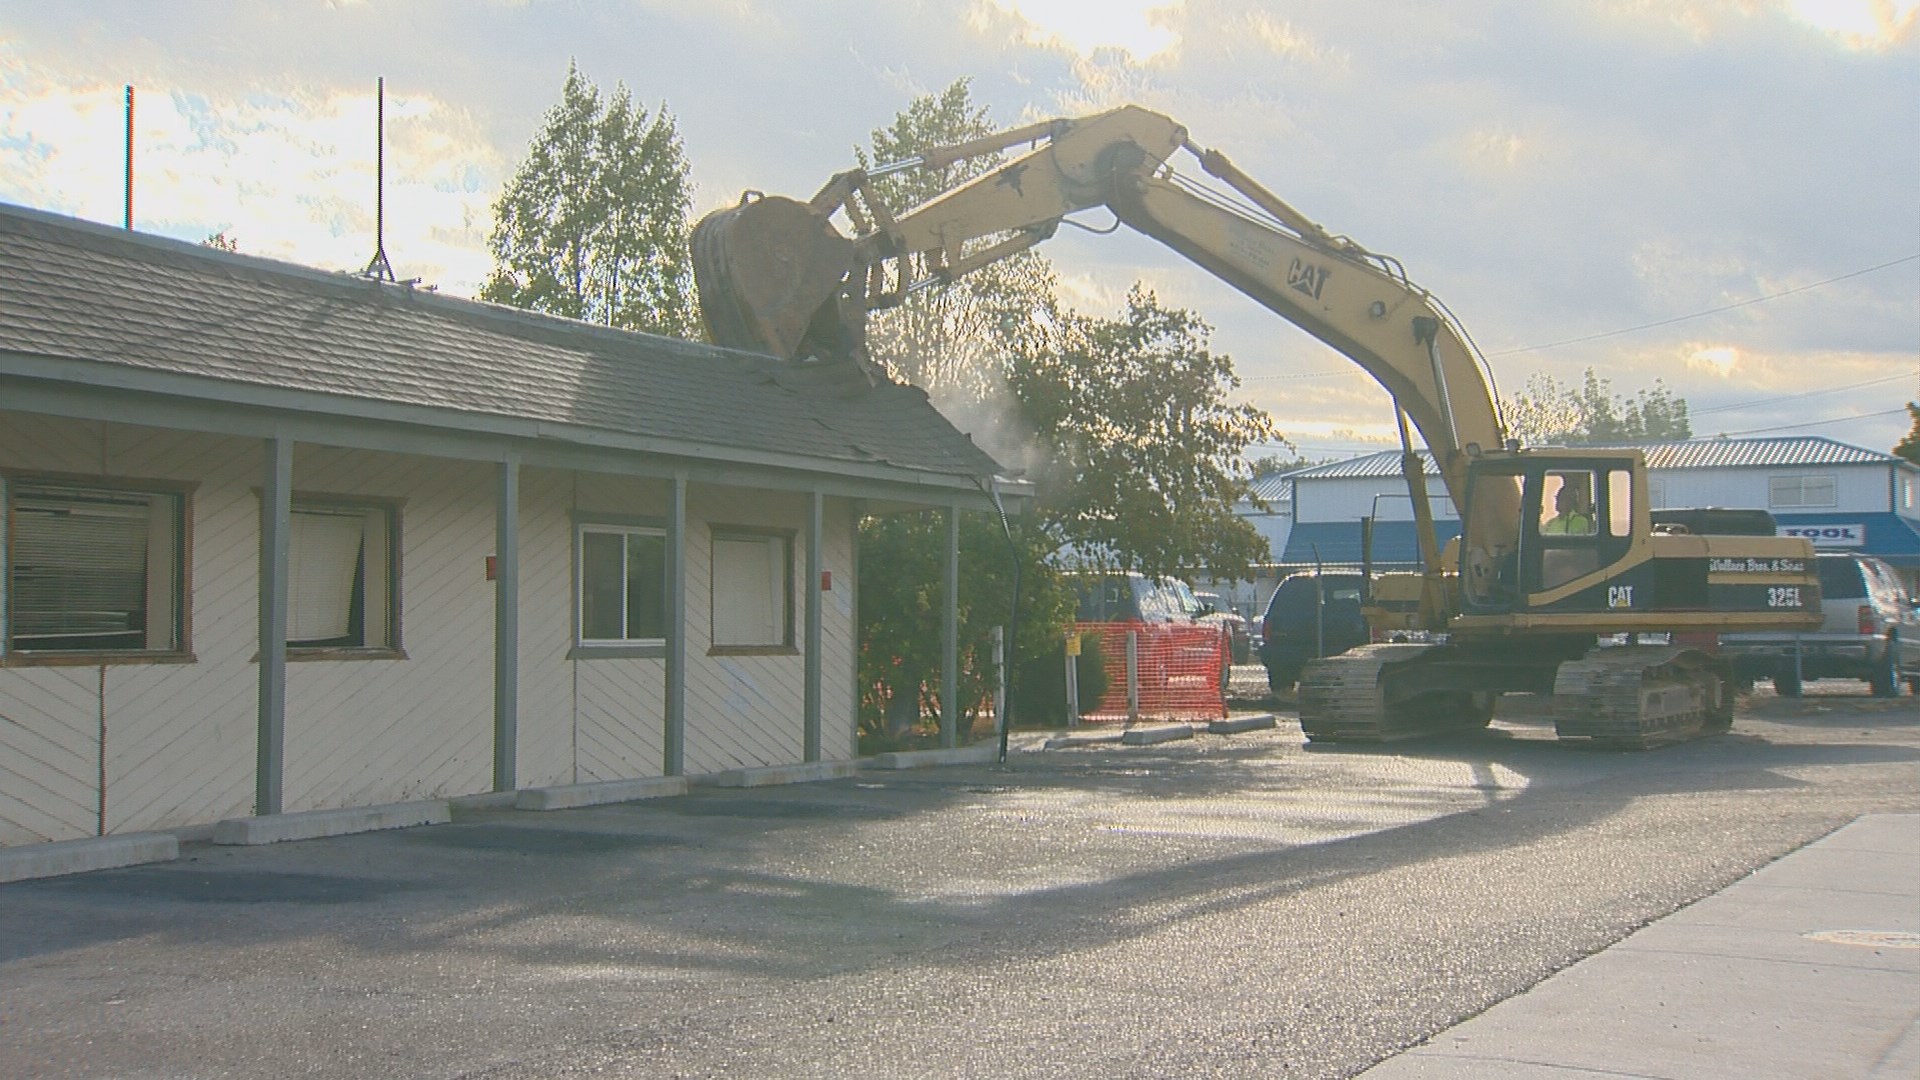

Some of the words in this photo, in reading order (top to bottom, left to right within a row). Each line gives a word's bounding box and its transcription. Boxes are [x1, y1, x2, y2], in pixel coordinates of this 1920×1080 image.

[1287, 257, 1332, 300] CAT
[1785, 528, 1856, 538] TOOL
[1608, 585, 1633, 608] CAT
[1767, 587, 1802, 607] 325L
